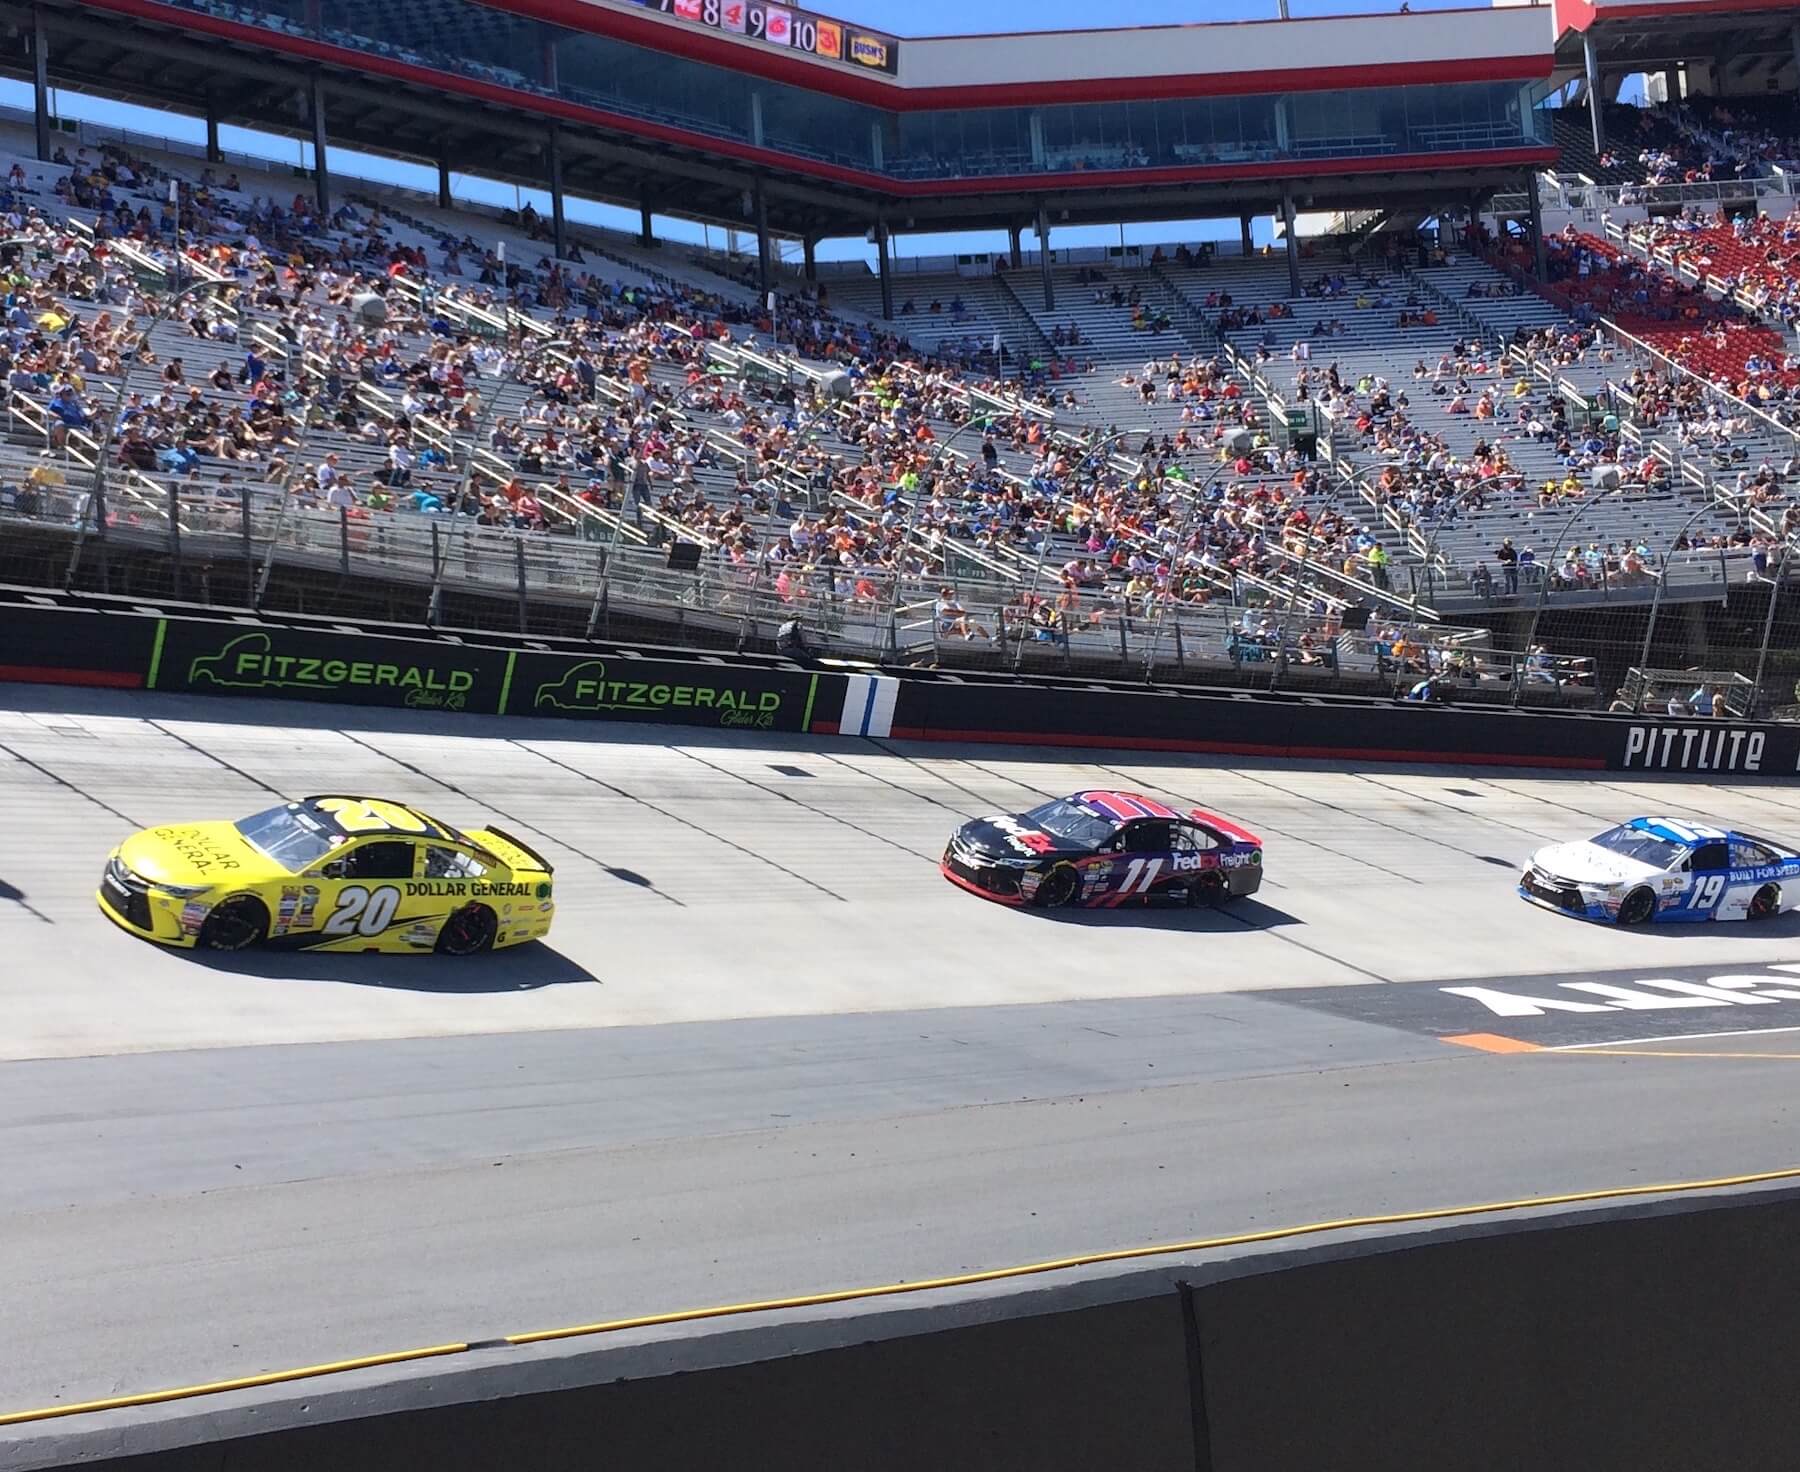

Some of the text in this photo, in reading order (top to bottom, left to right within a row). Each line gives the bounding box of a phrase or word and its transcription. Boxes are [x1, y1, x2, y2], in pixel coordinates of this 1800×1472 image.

[704, 0, 719, 26] 8
[751, 8, 764, 36] 9
[793, 21, 816, 51] 10
[235, 653, 474, 691] FITZGERALD
[575, 680, 781, 712] FITZGERALD
[1117, 858, 1164, 893] 11
[1220, 852, 1250, 868] Freight
[1729, 869, 1755, 882] BUILT
[1756, 866, 1775, 879] FOR
[405, 882, 532, 897] DOLLAR GENERAL
[1686, 875, 1726, 910] 19
[321, 885, 401, 937] 20
